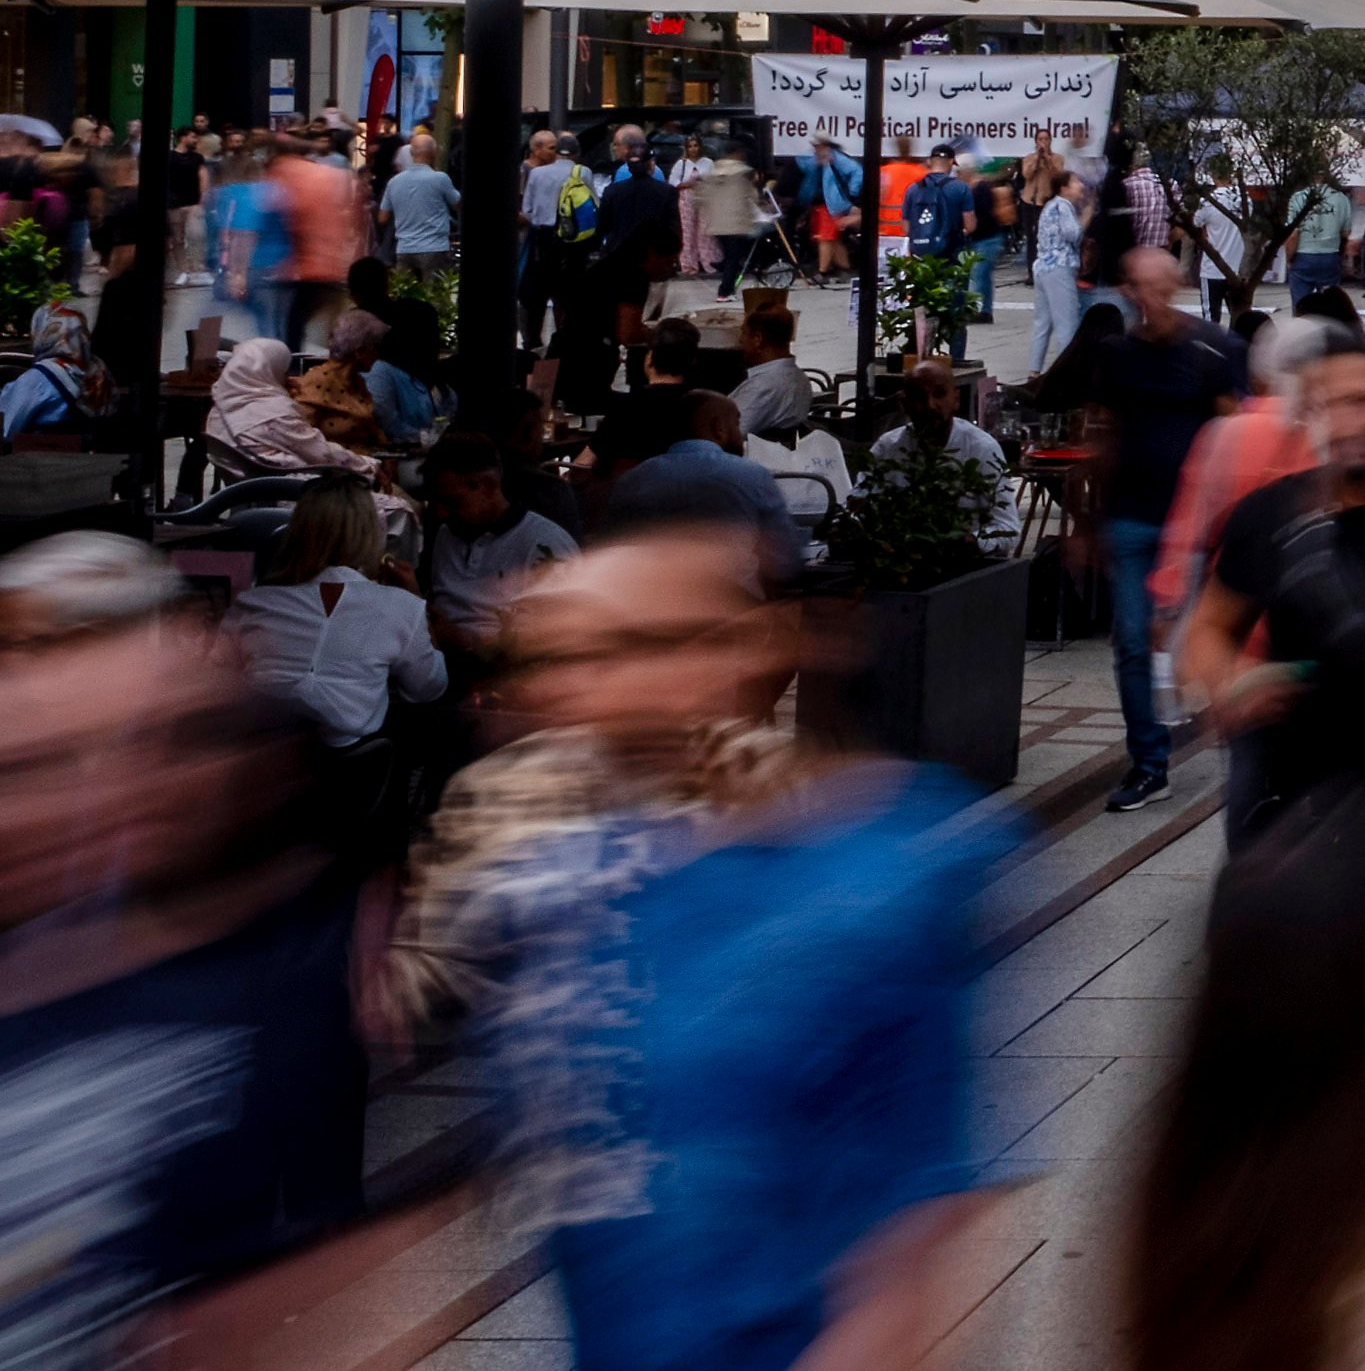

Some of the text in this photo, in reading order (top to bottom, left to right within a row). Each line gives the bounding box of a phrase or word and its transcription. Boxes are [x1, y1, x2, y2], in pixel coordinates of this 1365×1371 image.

[890, 66, 930, 98] آزاد
[815, 115, 839, 137] All
[846, 115, 921, 138] Potical
[927, 116, 1017, 139] Prisoners
[1023, 116, 1040, 139] in
[1046, 116, 1089, 139] Iran!
